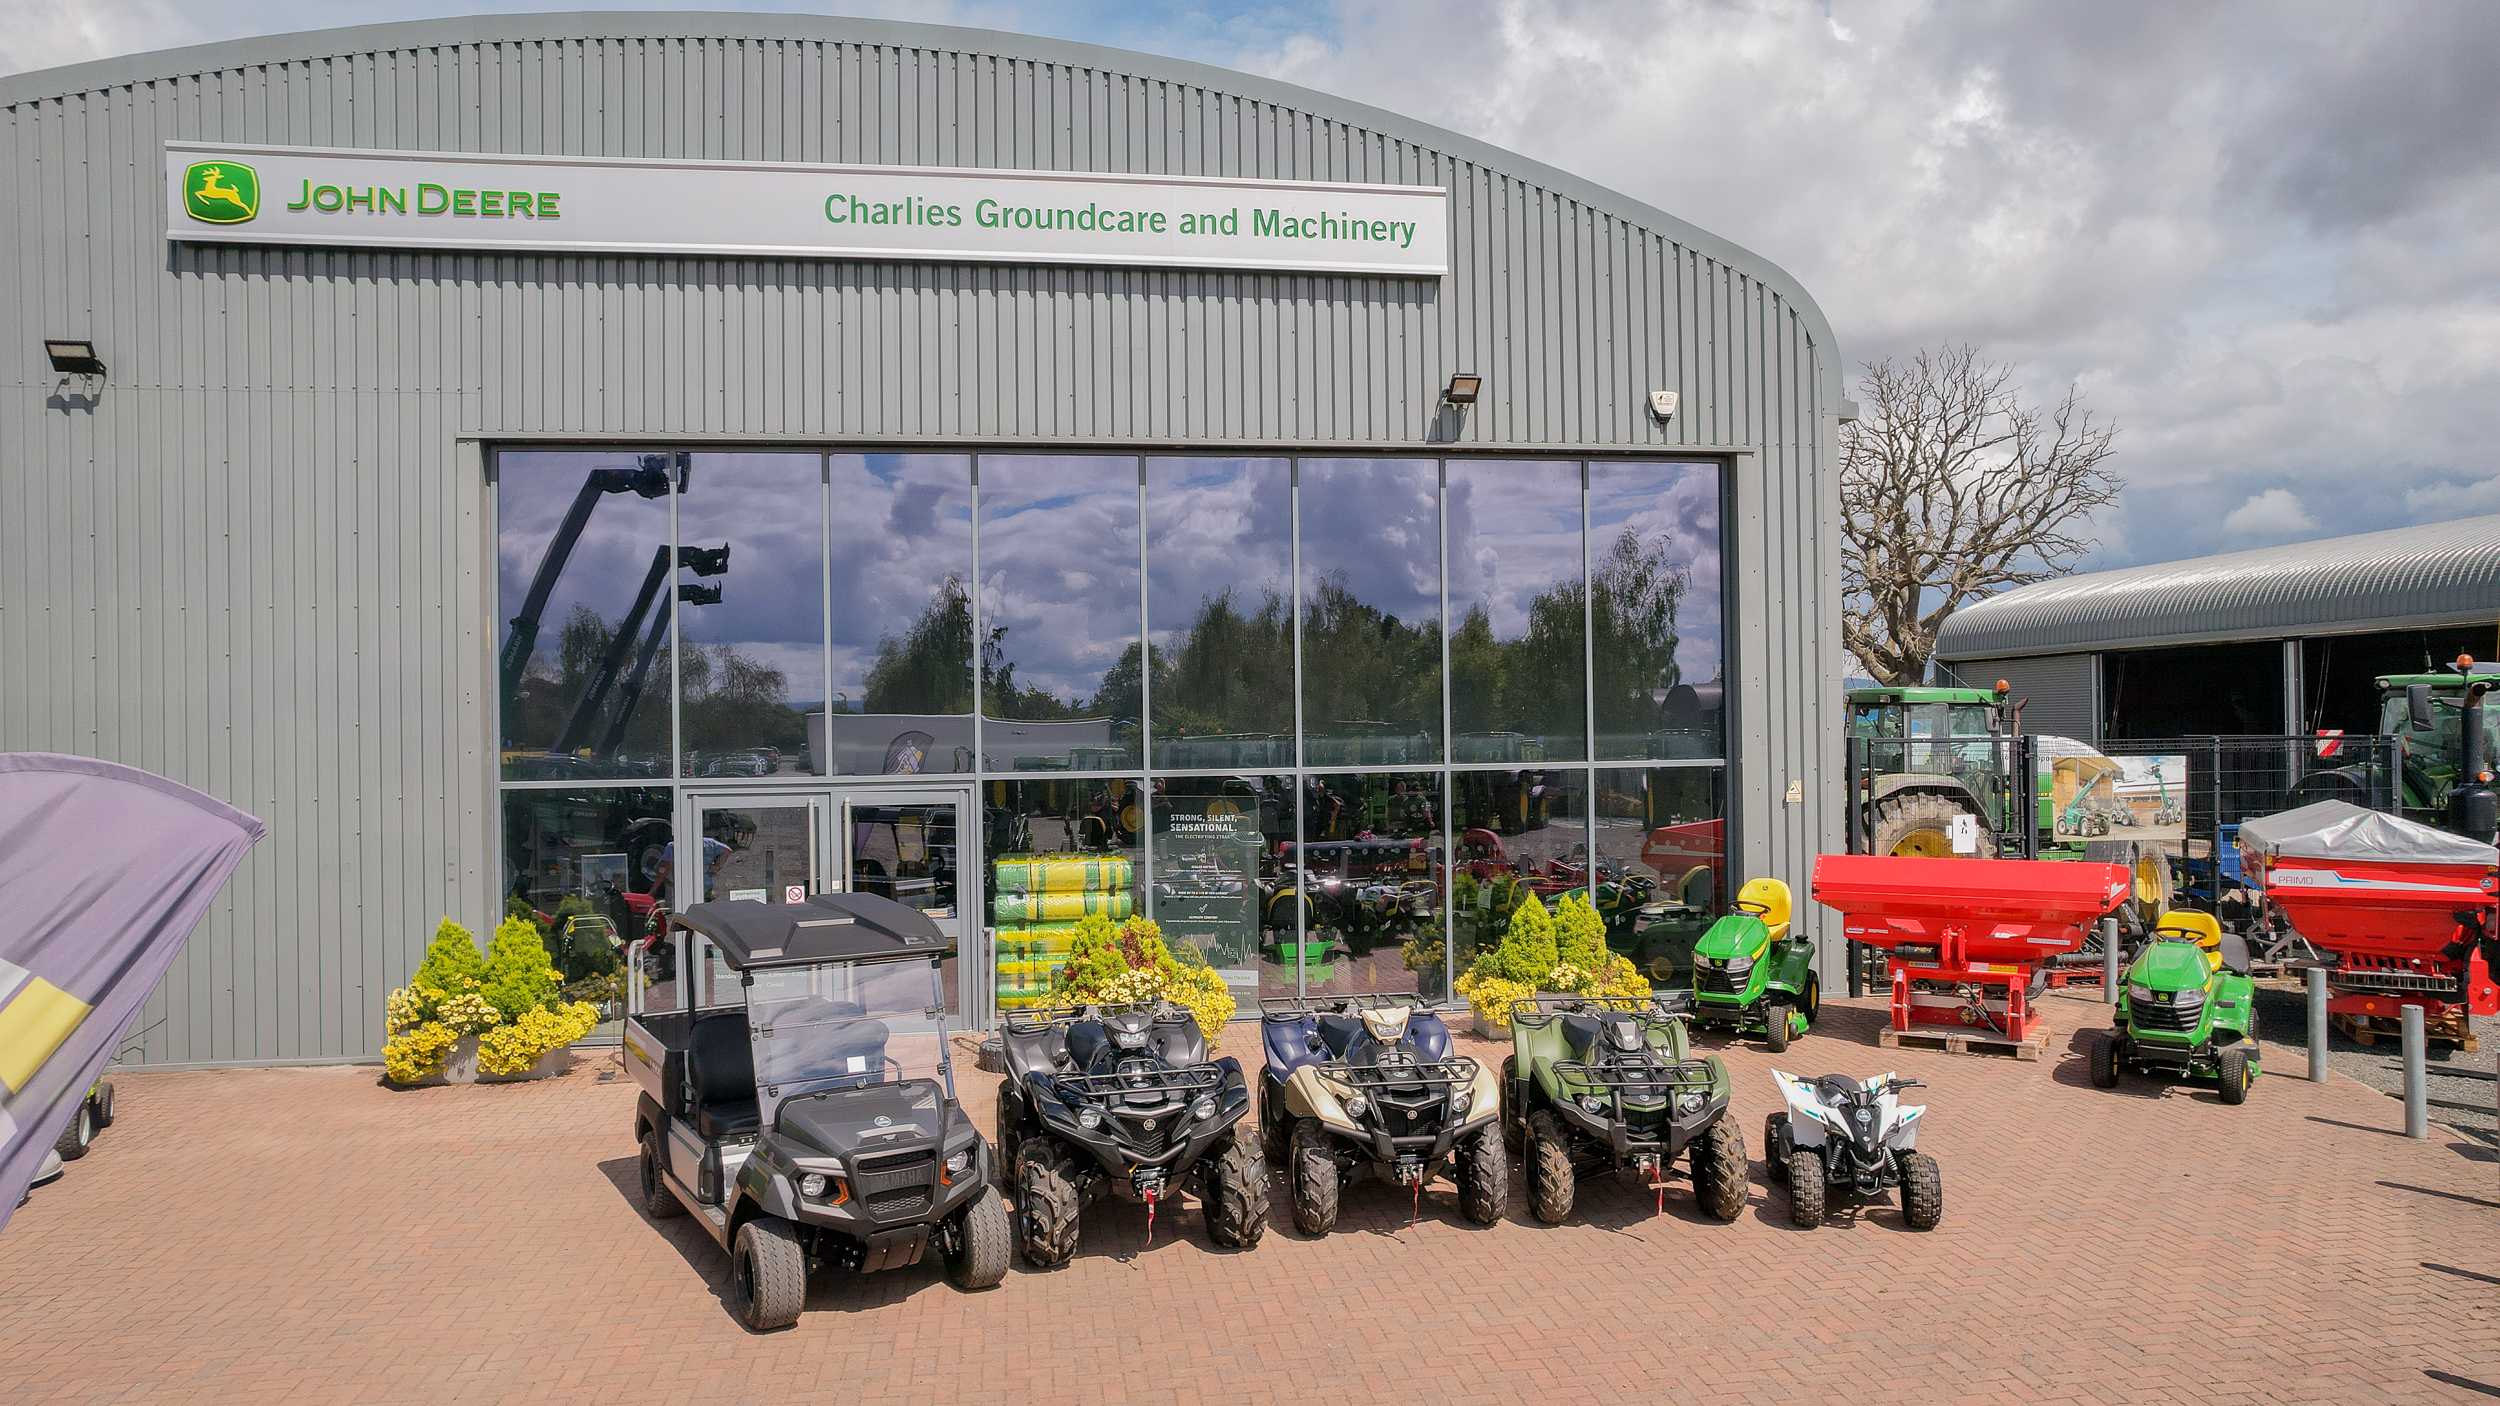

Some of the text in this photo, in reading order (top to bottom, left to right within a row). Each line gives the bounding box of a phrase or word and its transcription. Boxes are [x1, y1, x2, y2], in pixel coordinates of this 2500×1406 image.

[287, 178, 562, 217] JOHN DEERE
[825, 194, 1416, 249] Charlies Groundcare and Machinery
[1170, 813, 1238, 823] STRONG, SILENT,
[1170, 823, 1238, 832] SENSATIONAL.
[2278, 876, 2314, 885] PRIMO
